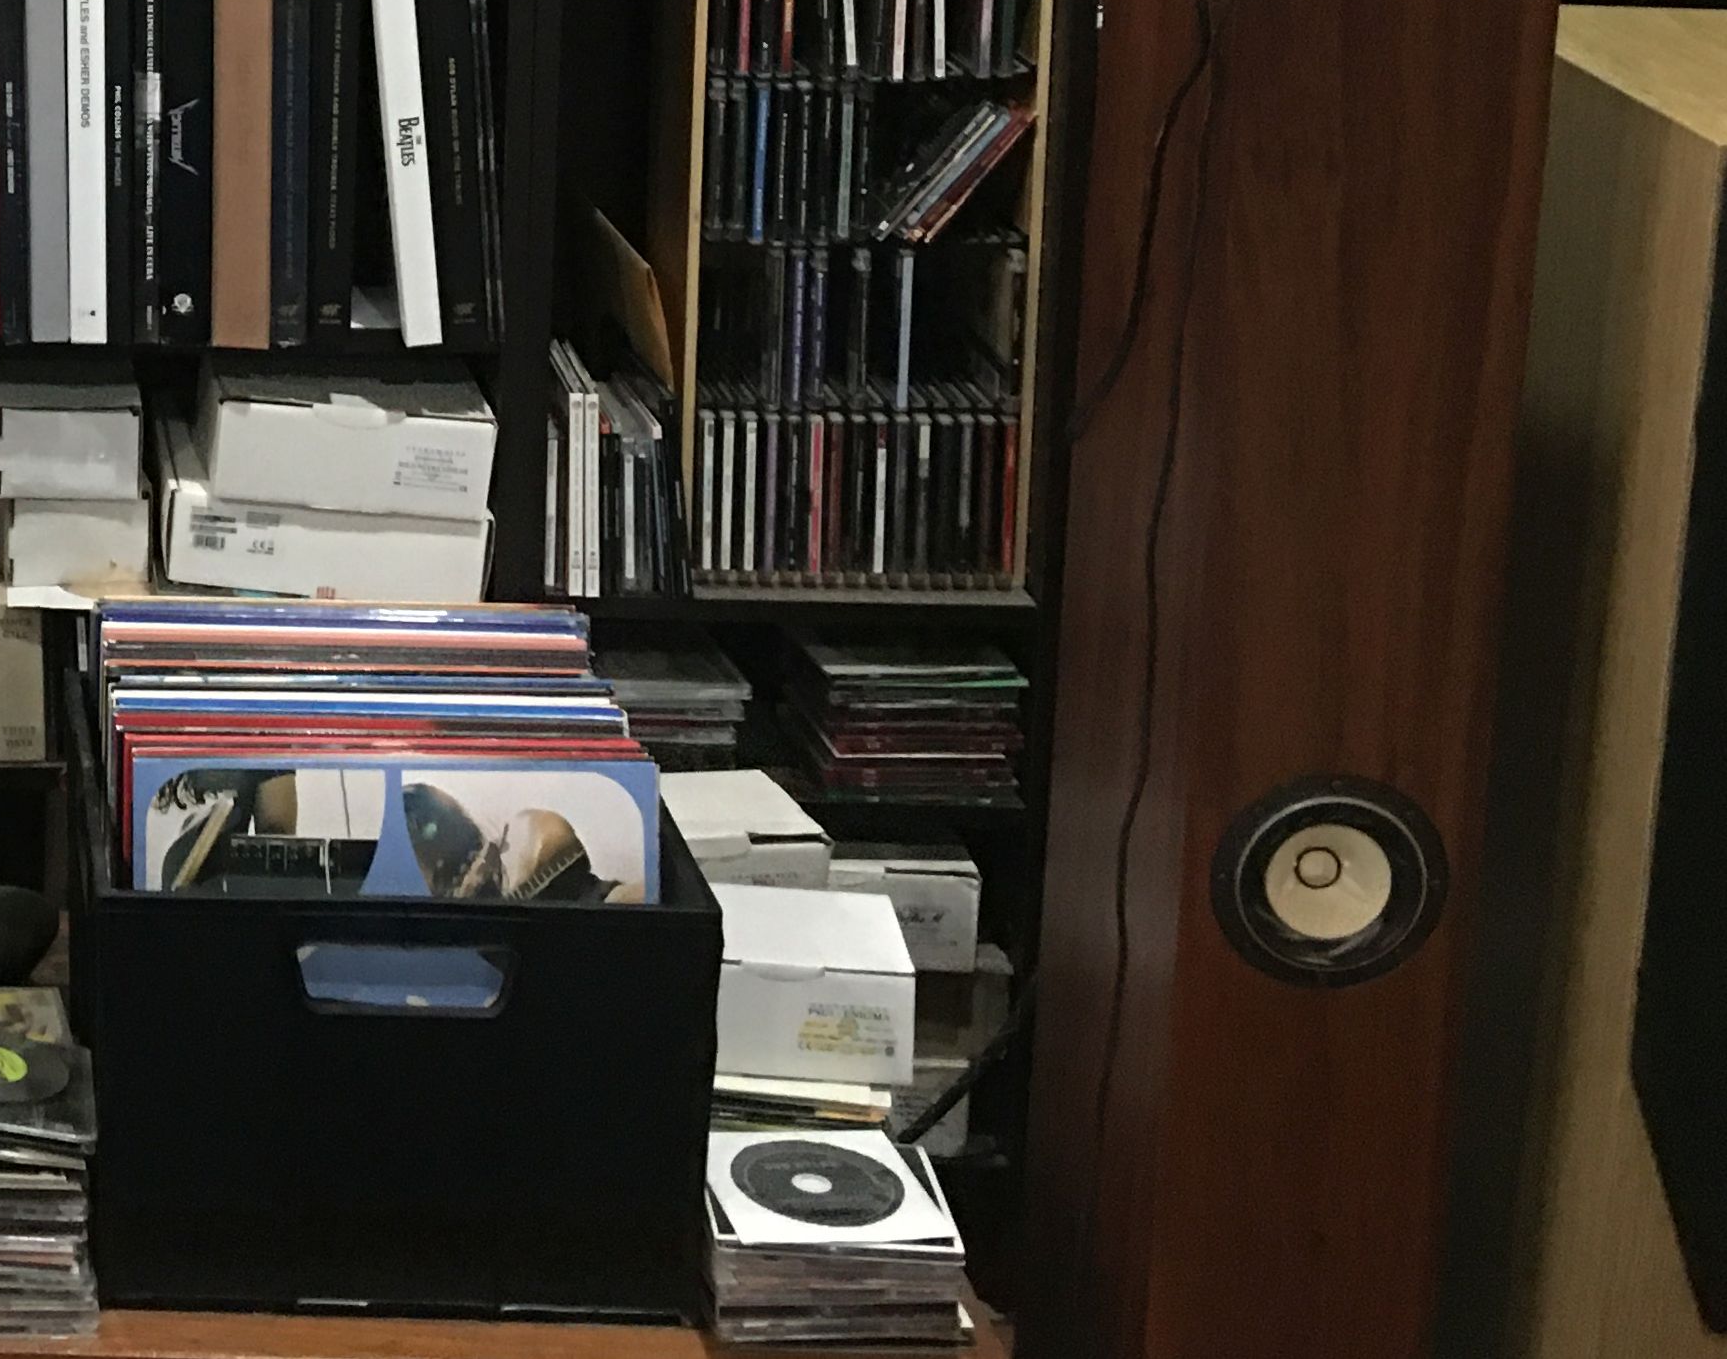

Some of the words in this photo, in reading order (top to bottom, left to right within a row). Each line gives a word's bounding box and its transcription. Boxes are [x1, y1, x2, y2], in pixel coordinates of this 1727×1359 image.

[80, 25, 90, 45] and
[80, 48, 90, 85] ESHER
[80, 88, 90, 128] DEMOS
[396, 116, 420, 166] BEATLES
